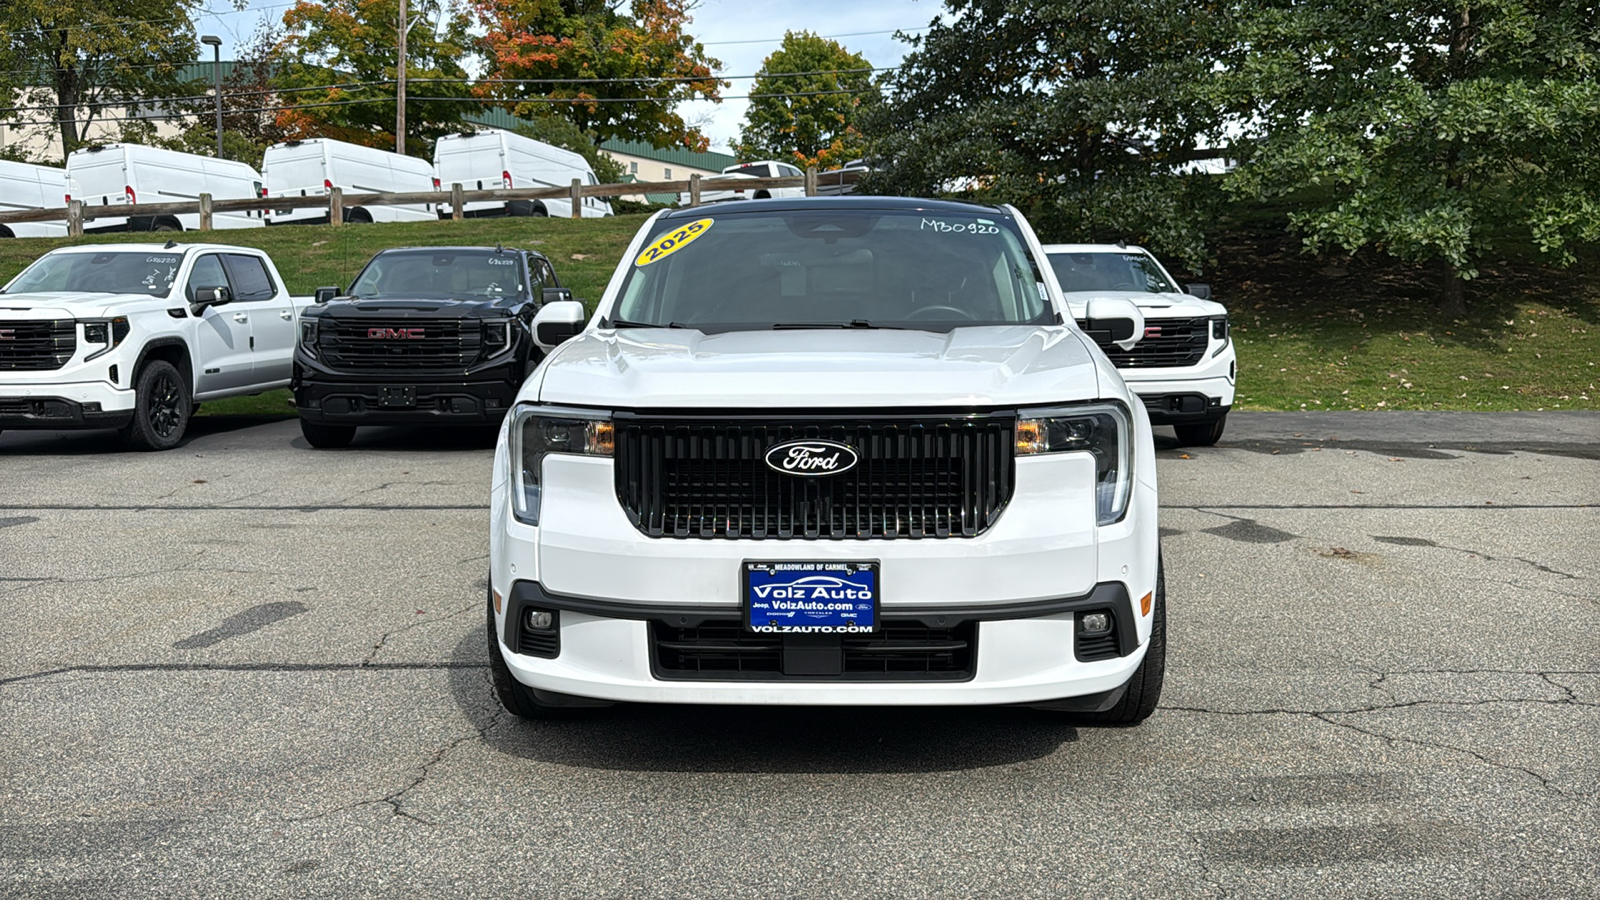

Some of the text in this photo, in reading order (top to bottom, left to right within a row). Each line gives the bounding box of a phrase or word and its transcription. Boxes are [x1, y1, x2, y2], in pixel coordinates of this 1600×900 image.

[645, 221, 704, 261] 2025
[367, 327, 426, 339] GMC
[782, 446, 840, 470] Ford
[774, 563, 815, 571] MEADOWLAND
[816, 563, 824, 571] OF
[825, 563, 848, 571] CARMEL
[753, 586, 872, 600] Volz Auto
[772, 600, 853, 611] VolzAuto.com
[752, 625, 873, 634] VOLZAUTO.COM
